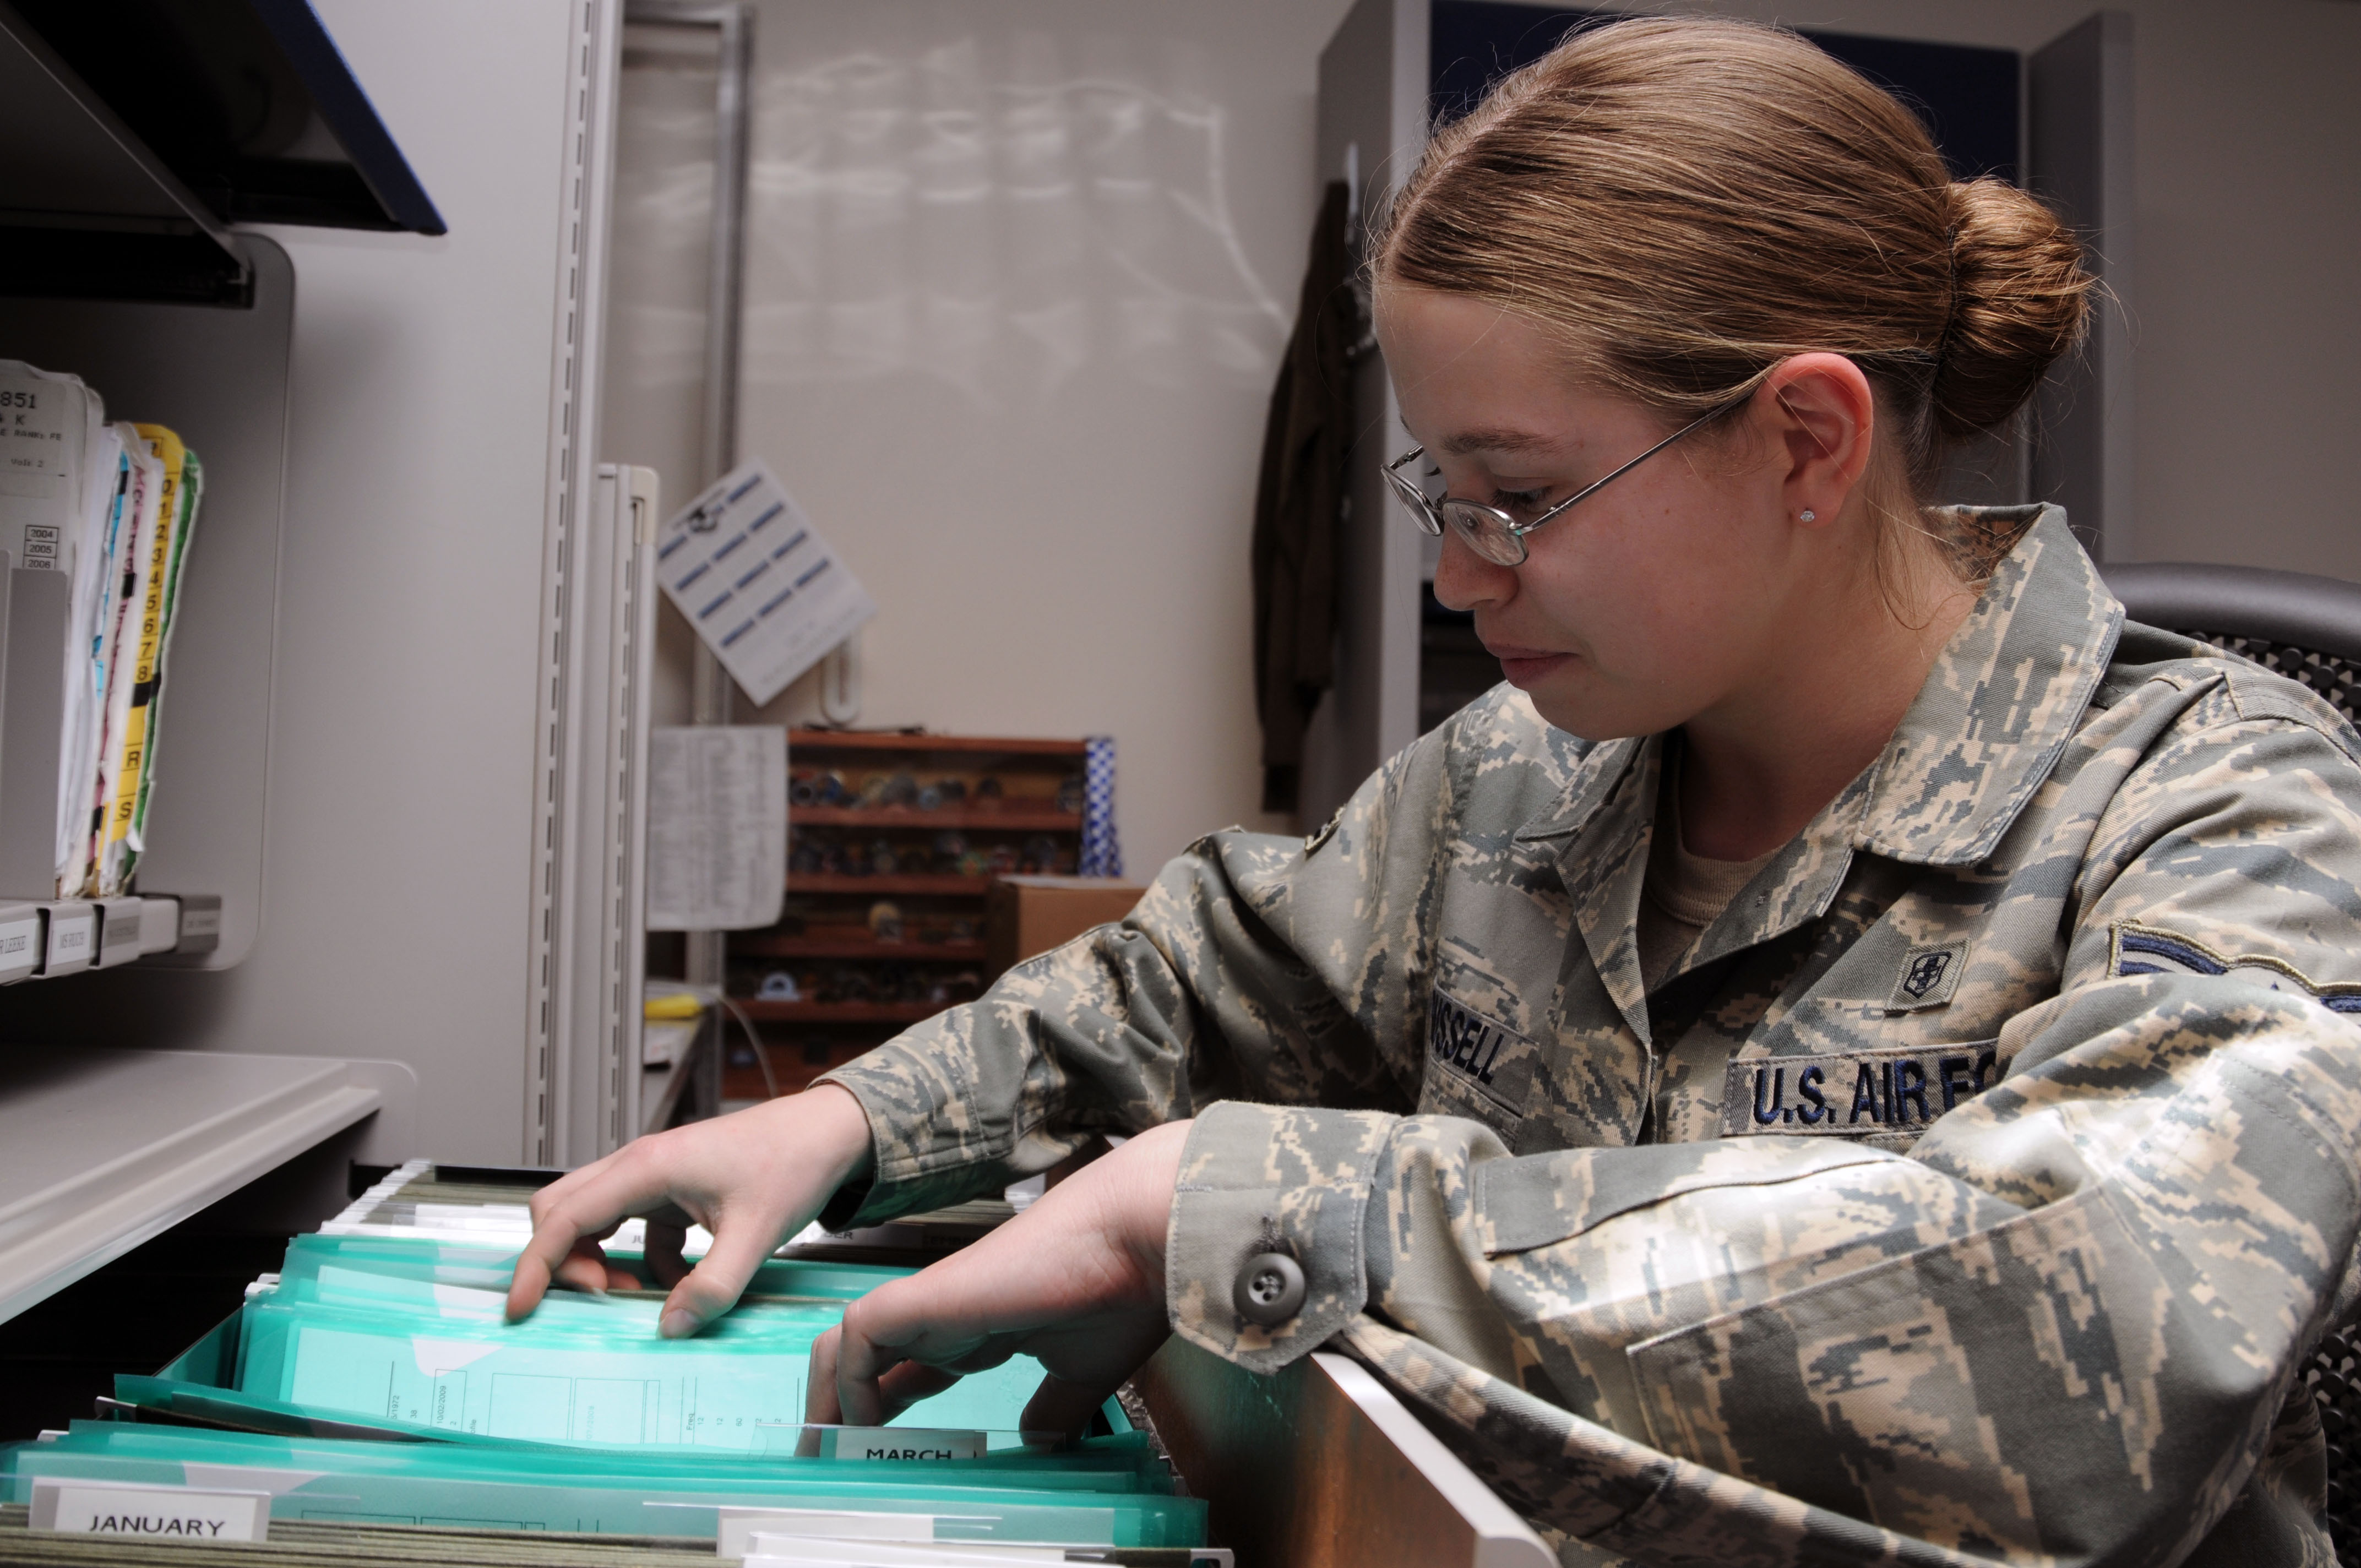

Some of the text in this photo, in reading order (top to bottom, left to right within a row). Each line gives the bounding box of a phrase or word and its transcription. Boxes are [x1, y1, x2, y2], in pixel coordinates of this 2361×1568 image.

[1, 391, 36, 409] 851
[31, 529, 53, 538] 2004
[30, 545, 52, 553] 2005
[28, 559, 51, 569] 2006
[144, 618, 154, 633] 6
[142, 641, 151, 656] 7
[138, 666, 148, 680] 8
[127, 751, 140, 767] R
[119, 802, 131, 818] S
[1754, 1065, 1836, 1125] U.S.
[1849, 1059, 1931, 1124] AIR
[437, 1386, 446, 1424] 10/02/2009
[866, 1449, 951, 1460] MARCH
[89, 1516, 225, 1537] JANUARY
